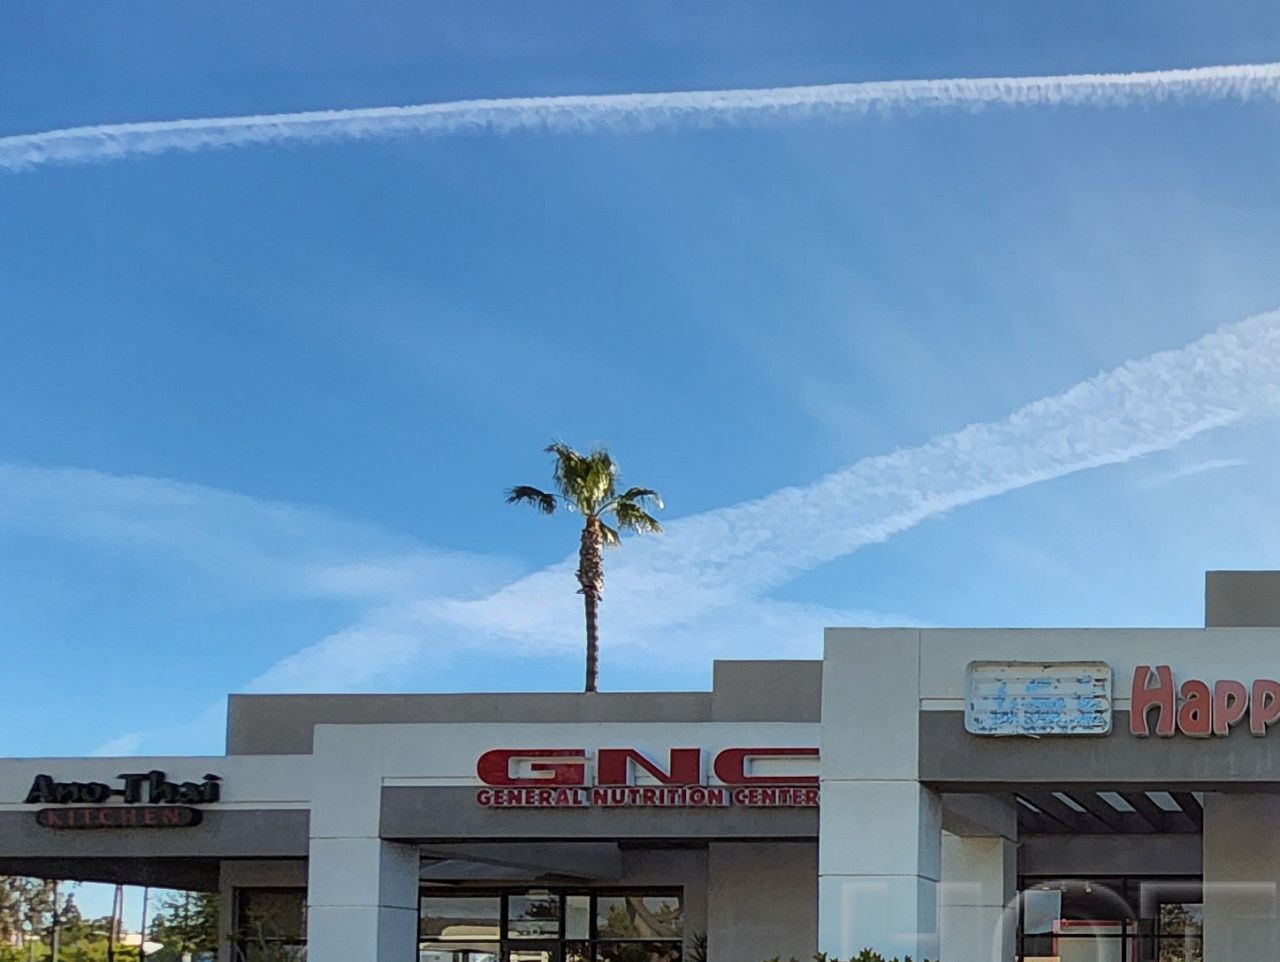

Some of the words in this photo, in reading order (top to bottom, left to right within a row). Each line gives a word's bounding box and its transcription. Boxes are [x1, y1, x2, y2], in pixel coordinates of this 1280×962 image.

[476, 748, 820, 786] GNC
[475, 787, 584, 807] GENERAL
[592, 787, 728, 807] NUTRITION
[46, 807, 183, 828] KITCHEN
